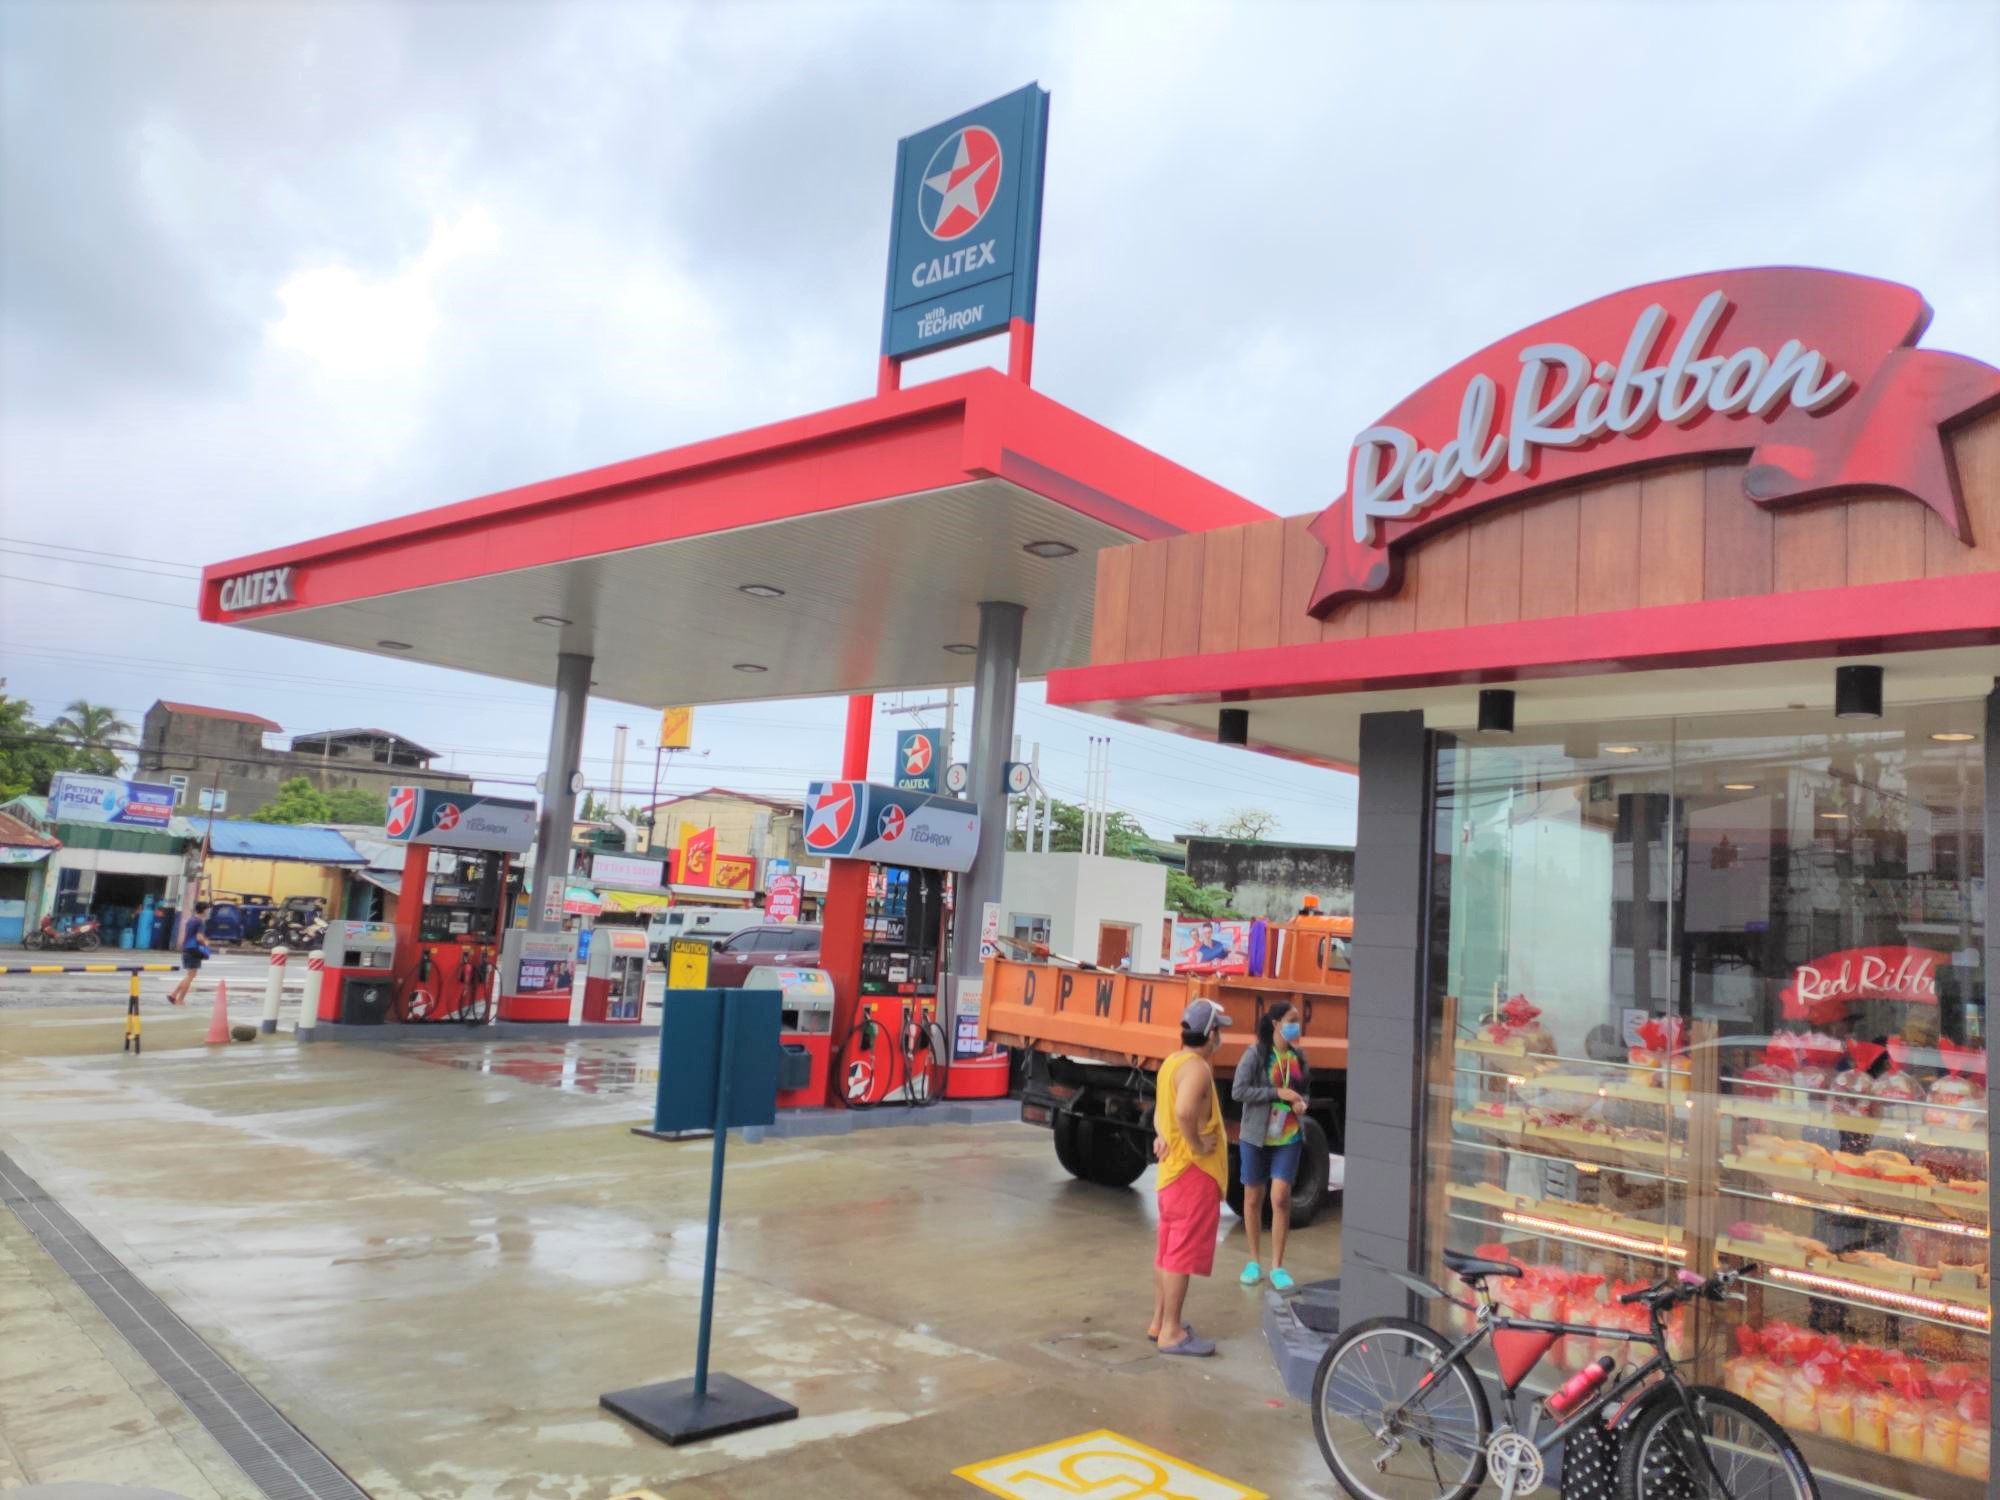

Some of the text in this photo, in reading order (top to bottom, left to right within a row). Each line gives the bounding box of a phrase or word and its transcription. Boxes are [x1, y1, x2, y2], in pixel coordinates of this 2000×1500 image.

[911, 239, 997, 288] CALTEX
[916, 304, 985, 339] TECHRON
[924, 306, 945, 321] with
[1352, 289, 1854, 545] Red Ribbon
[220, 566, 290, 612] CALTEX
[898, 778, 930, 790] CALTEX
[953, 770, 961, 785] 3
[1014, 770, 1023, 785] 4
[64, 783, 104, 796] PETRON
[910, 828, 952, 847] TECHRON
[674, 942, 708, 954] CAUTION
[1796, 954, 1936, 1006] Red Ribb
